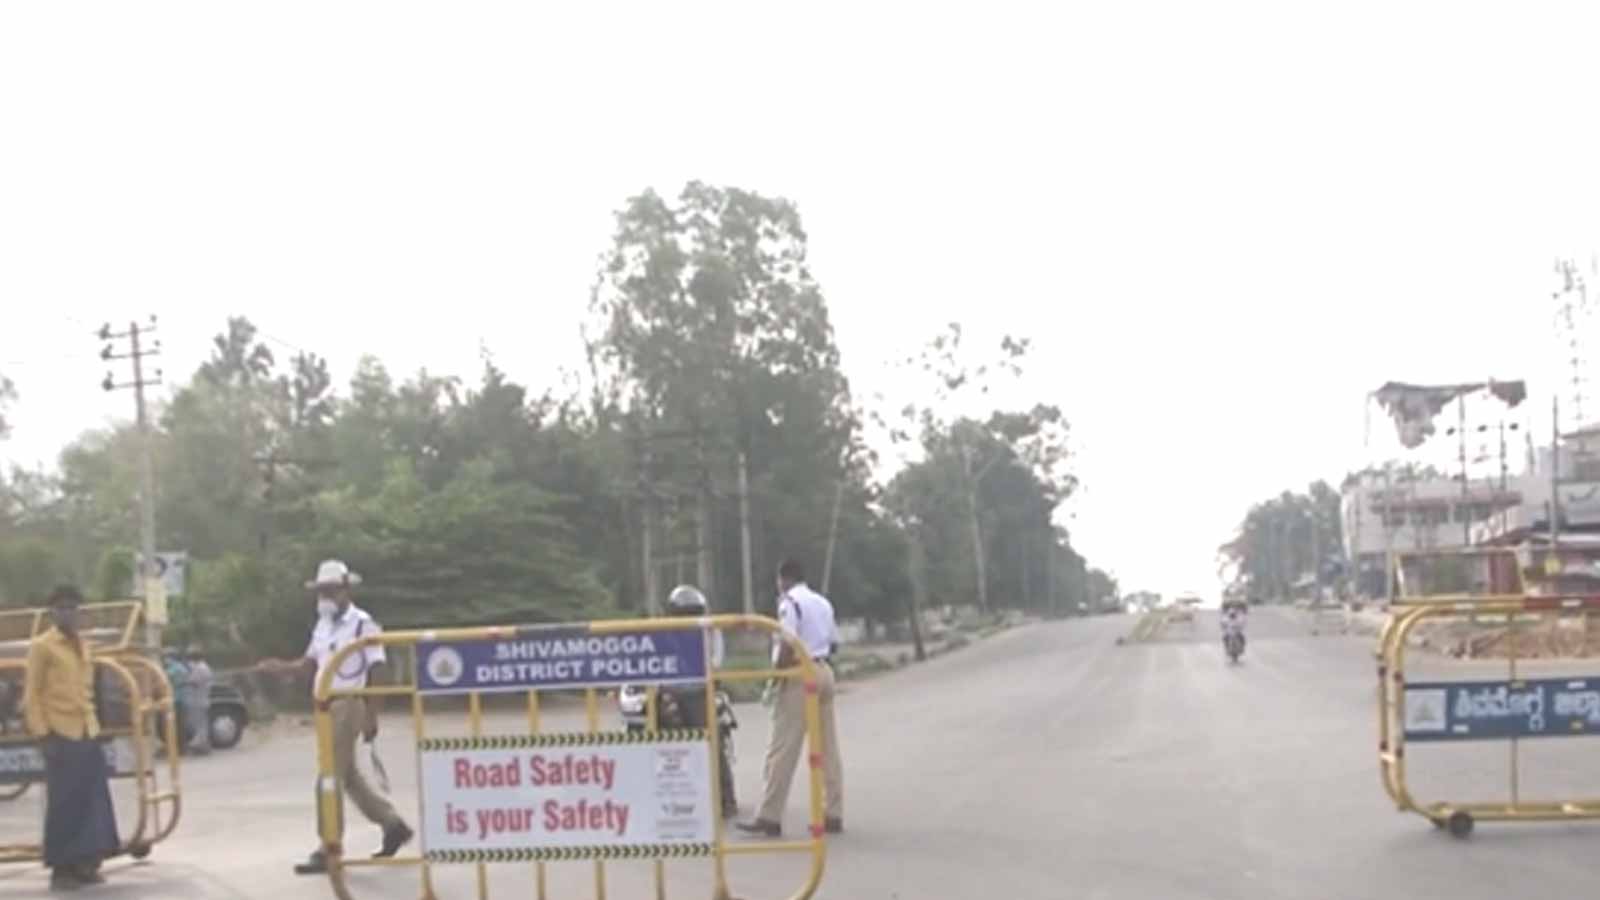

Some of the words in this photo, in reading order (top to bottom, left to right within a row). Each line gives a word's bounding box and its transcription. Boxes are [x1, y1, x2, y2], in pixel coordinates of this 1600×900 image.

[495, 635, 655, 659] SHIVAMOGGA
[475, 658, 586, 683] DISTRICT
[591, 656, 678, 677] POLICE
[453, 757, 521, 789] Road
[530, 754, 616, 788] Safety
[445, 803, 469, 834] is
[476, 806, 534, 840] your
[543, 800, 630, 836] Safety
